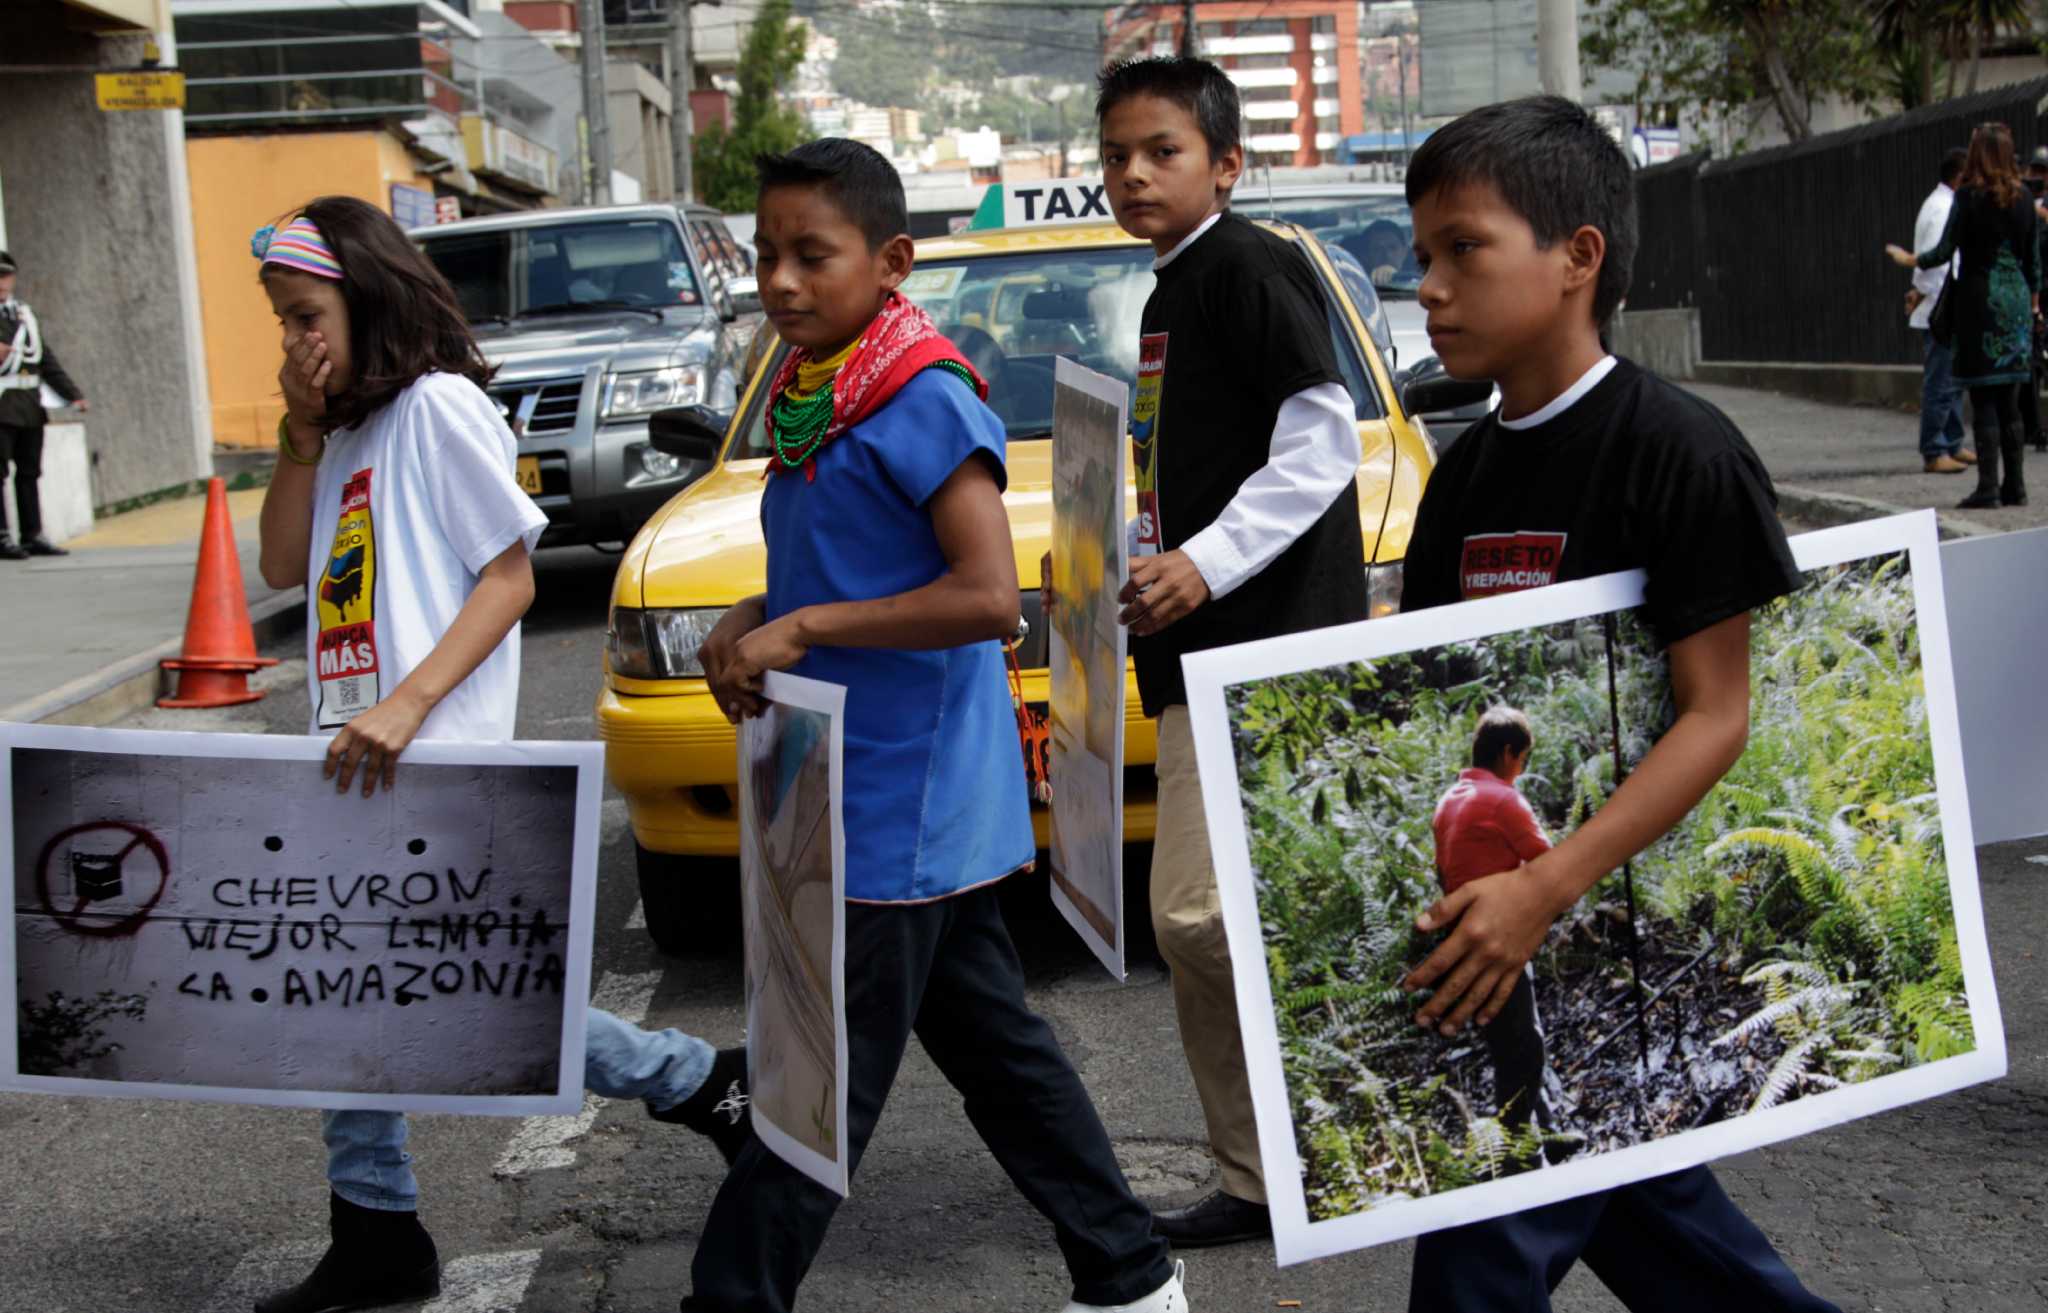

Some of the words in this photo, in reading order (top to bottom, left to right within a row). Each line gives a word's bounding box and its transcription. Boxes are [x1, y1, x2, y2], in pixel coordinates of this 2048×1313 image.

[1014, 185, 1109, 220] TAX
[323, 626, 368, 649] NUNCA
[321, 639, 374, 675] MÁS
[213, 868, 492, 909] CHEVRON
[178, 971, 233, 1001] LA
